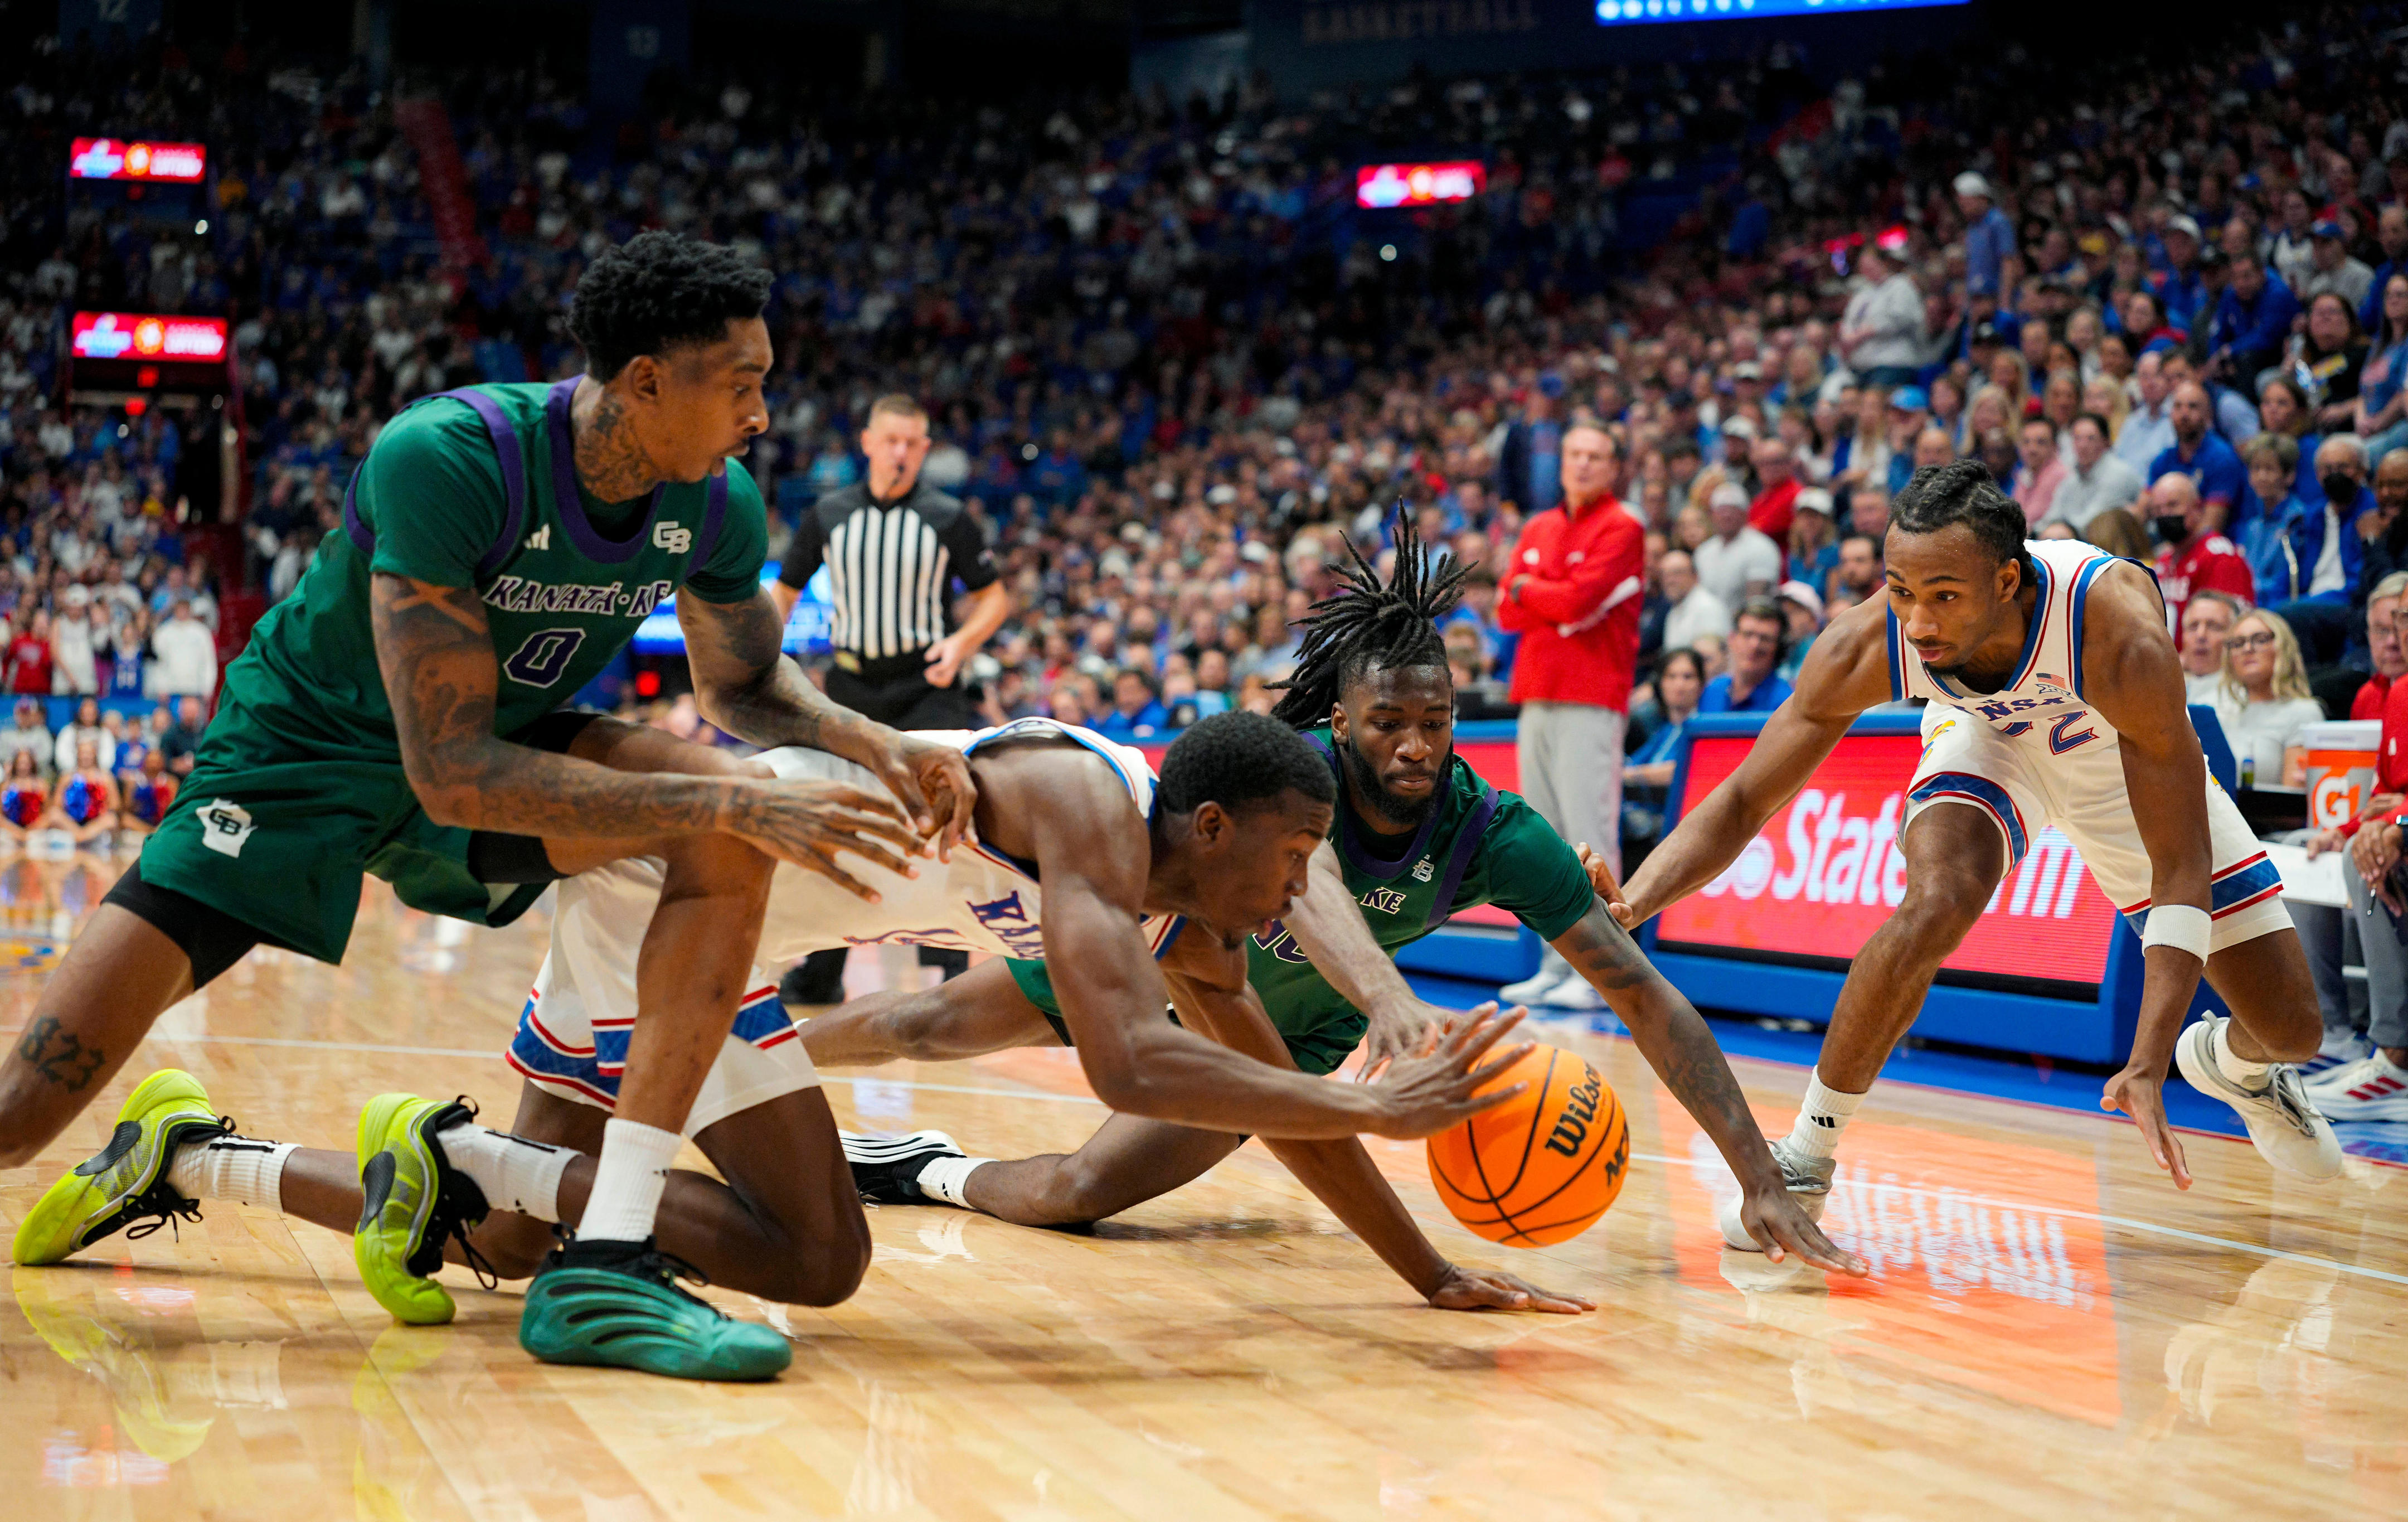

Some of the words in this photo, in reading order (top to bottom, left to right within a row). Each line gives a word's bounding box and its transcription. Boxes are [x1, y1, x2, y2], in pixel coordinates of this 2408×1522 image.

[653, 521, 692, 555] GB
[503, 628, 586, 689] 0
[1949, 697, 2066, 721] NSA
[209, 808, 241, 835] GB
[2315, 777, 2350, 829] G
[1771, 788, 1907, 907] State
